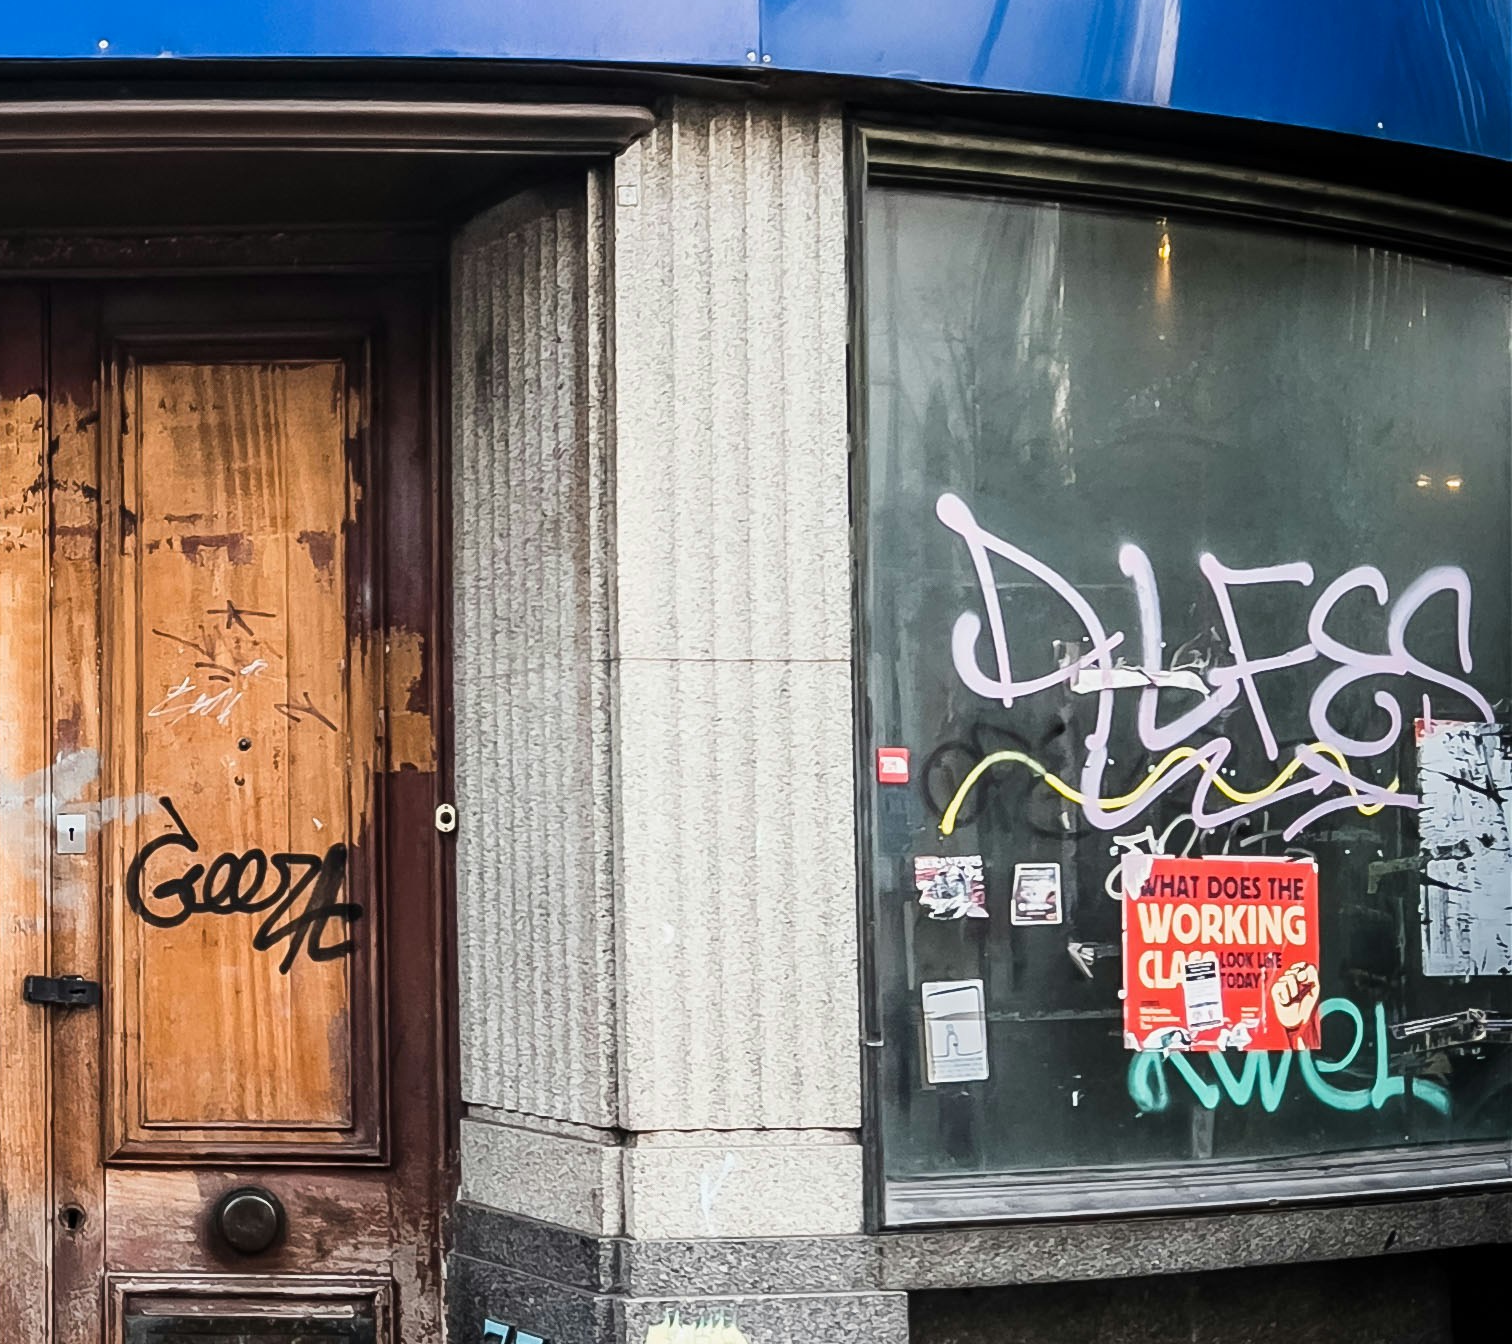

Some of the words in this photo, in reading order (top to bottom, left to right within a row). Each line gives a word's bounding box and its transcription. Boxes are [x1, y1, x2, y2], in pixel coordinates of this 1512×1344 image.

[1141, 874, 1200, 900] WHAT
[1207, 876, 1262, 900] DOES
[1267, 877, 1305, 901] THE
[1138, 903, 1307, 946] WORKING
[1219, 951, 1254, 970] LOOK
